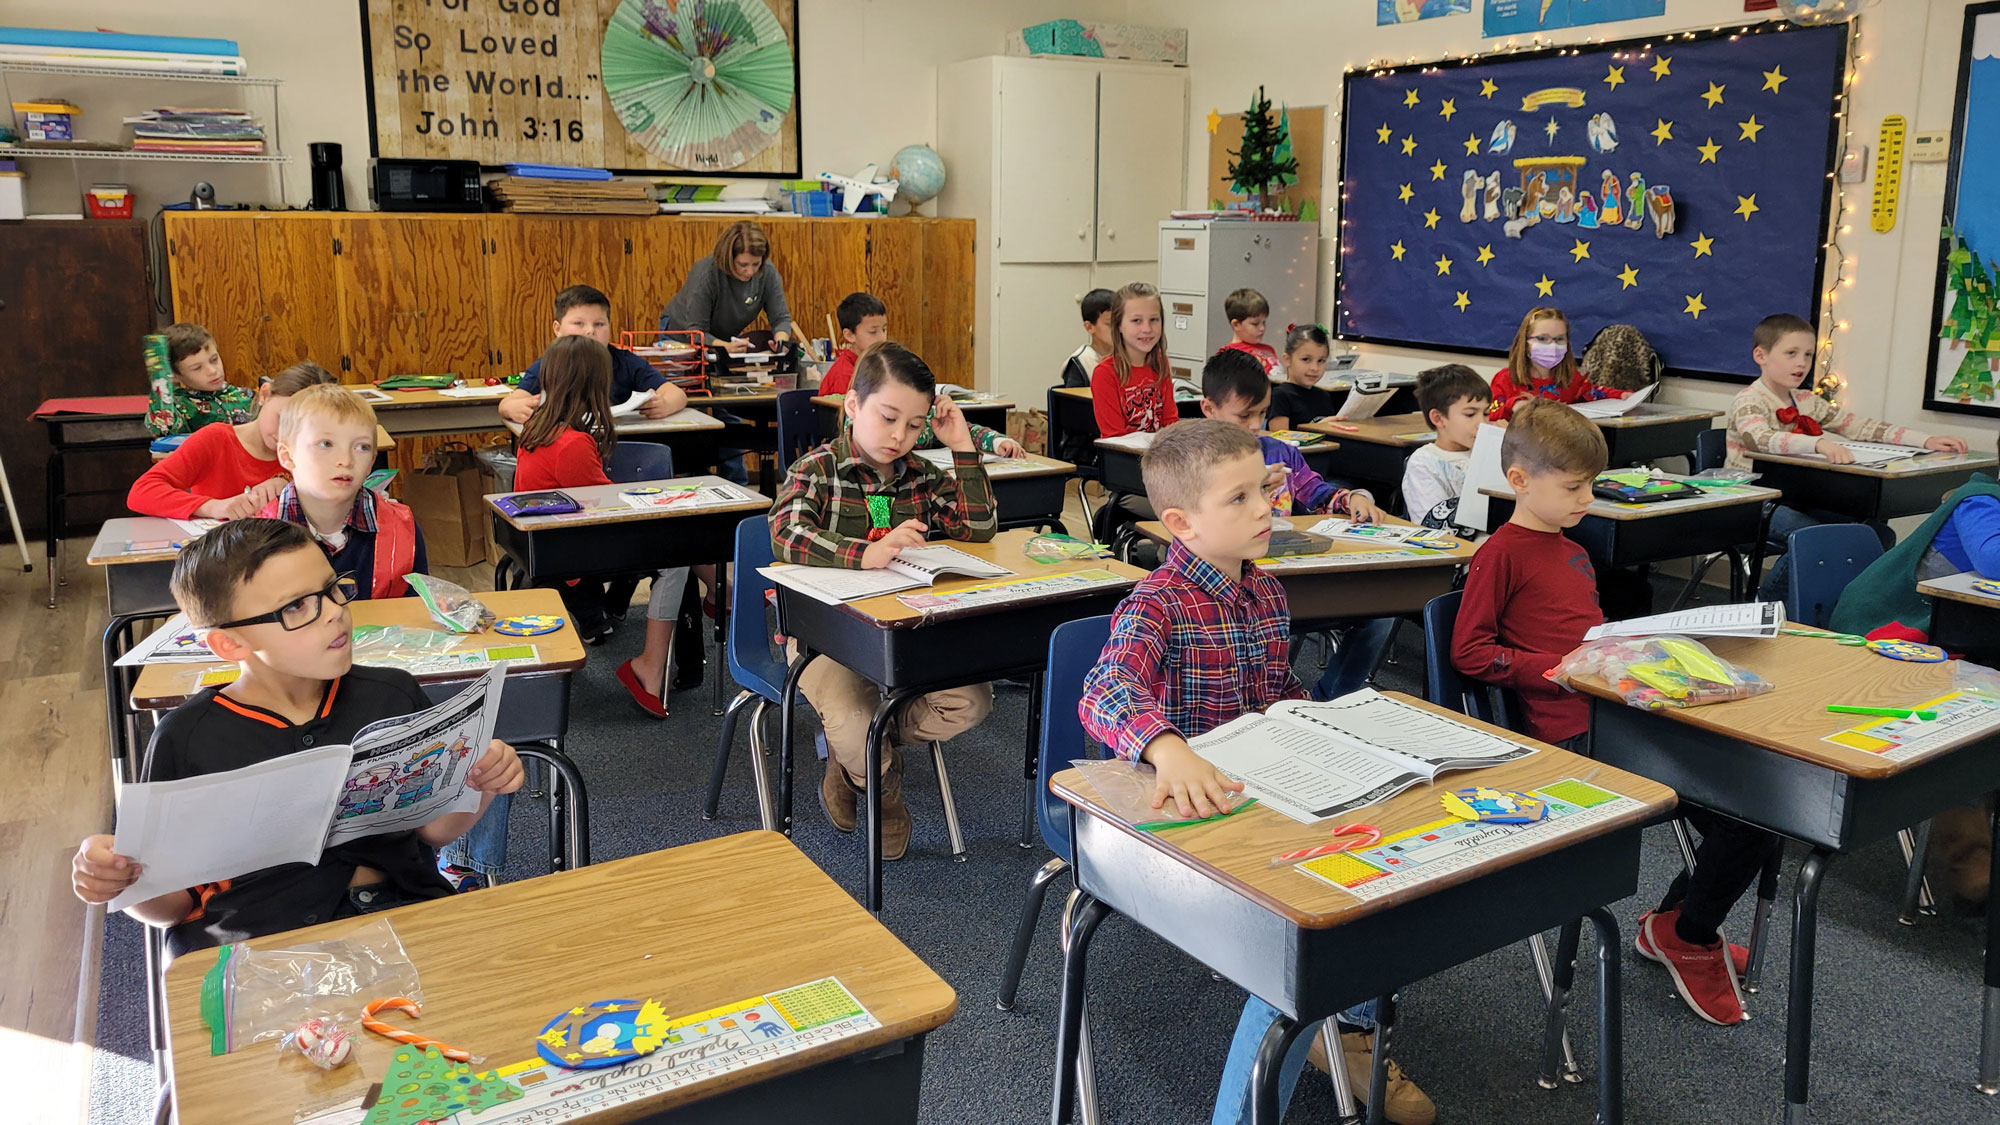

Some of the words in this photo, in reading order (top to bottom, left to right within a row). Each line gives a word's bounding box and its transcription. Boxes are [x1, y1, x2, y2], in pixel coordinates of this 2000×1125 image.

[425, 0, 468, 12] or
[499, 0, 561, 17] God
[394, 25, 431, 51] So
[460, 29, 557, 57] Loved
[397, 69, 450, 93] the
[416, 111, 498, 137] John
[523, 117, 584, 142] 3:16
[367, 748, 403, 764] Fluency
[406, 740, 424, 751] and
[425, 731, 448, 744] Close
[449, 710, 480, 732] Reading
[369, 730, 427, 757] Holiday
[429, 707, 469, 734] Carols
[835, 1021, 852, 1029] Bb
[796, 1032, 814, 1042] Dd
[738, 1048, 760, 1056] Gg
[762, 1043, 778, 1052] Ff
[719, 1054, 738, 1064] Hh
[690, 1062, 705, 1072] Jj
[578, 1062, 652, 1089] Ayala
[672, 1068, 691, 1078] Kk
[629, 1079, 656, 1088] Mm
[656, 1074, 671, 1084] Ll
[608, 1086, 628, 1096] Nn
[562, 1100, 581, 1110] Pp
[530, 1106, 559, 1116] Qq
